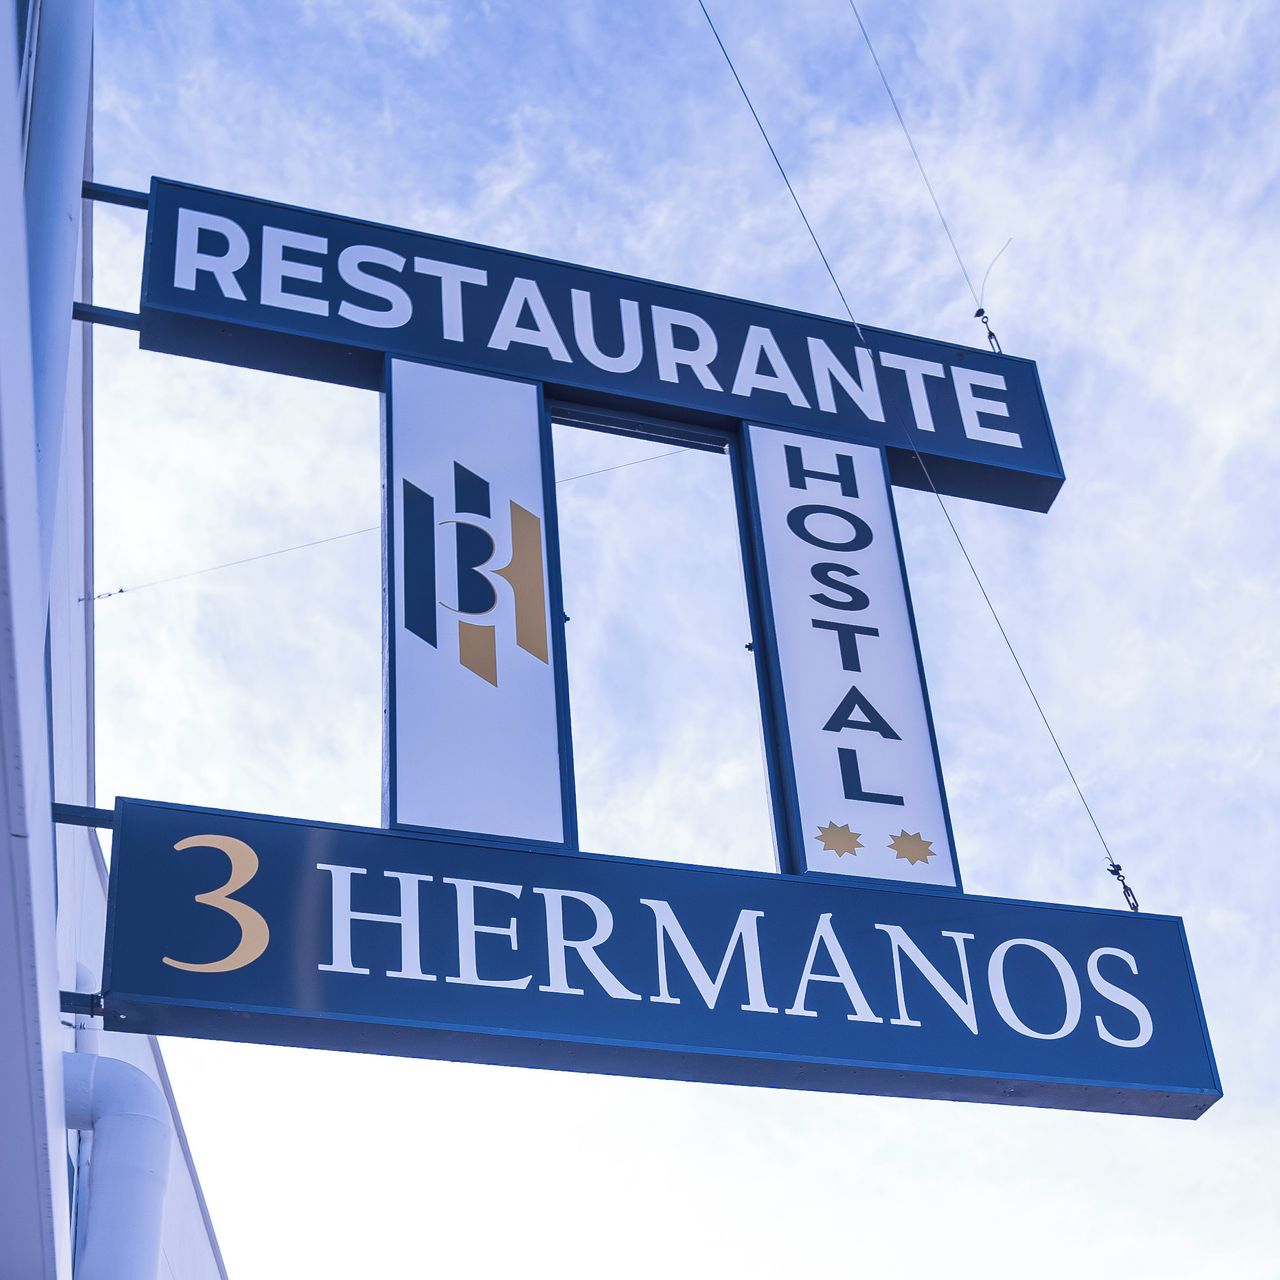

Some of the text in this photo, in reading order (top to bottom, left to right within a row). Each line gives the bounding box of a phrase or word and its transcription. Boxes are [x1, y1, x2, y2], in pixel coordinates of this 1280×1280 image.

[174, 208, 1023, 449] RESTAURANTE
[784, 445, 906, 807] HOSTAL
[162, 834, 1153, 1048] 3 HERMANOS
